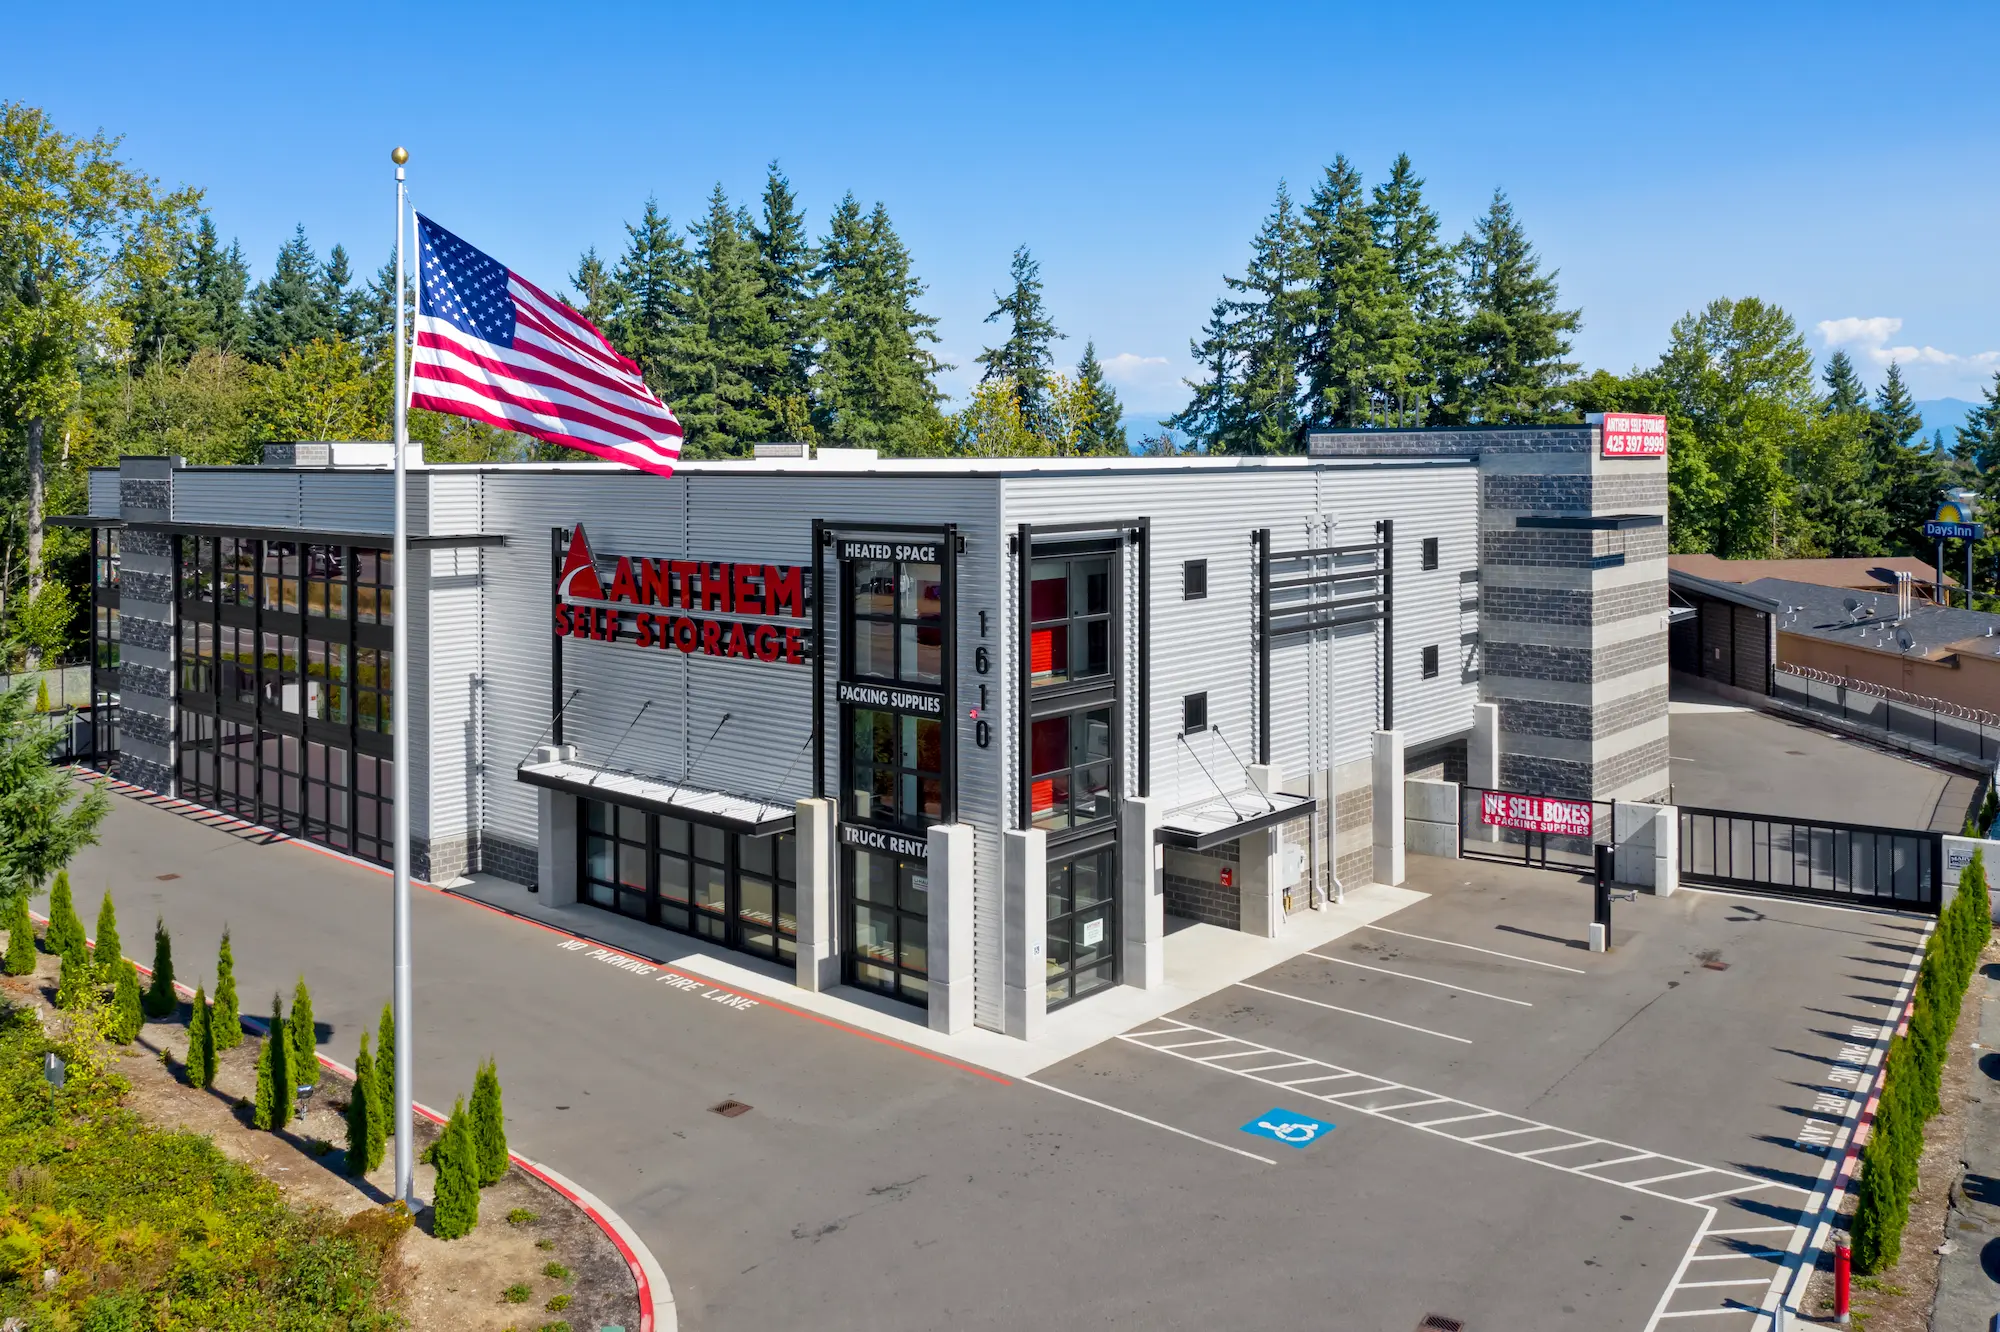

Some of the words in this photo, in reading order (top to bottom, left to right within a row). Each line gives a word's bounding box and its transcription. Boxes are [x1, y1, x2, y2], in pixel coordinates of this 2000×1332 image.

[1606, 418, 1630, 431] ANTHEM
[1630, 418, 1642, 433] SELF
[1642, 419, 1665, 433] STORAGE
[1606, 435, 1624, 452] 425
[1625, 435, 1642, 452] 397
[1643, 436, 1664, 452] 9999
[1927, 523, 1953, 536] Days
[1954, 525, 1972, 537] Inn
[845, 543, 891, 559] HEATED
[895, 545, 935, 562] SPACE
[610, 556, 804, 618] ANTHEM
[555, 603, 619, 643] SELF
[636, 612, 805, 665] STORAGE
[975, 610, 989, 748] 1610
[840, 685, 888, 706] PACKING
[891, 692, 940, 713] SUPPLIES
[1483, 814, 1491, 823] &
[1495, 816, 1537, 830] PACKING
[1540, 822, 1589, 835] SUPPLIES
[1484, 794, 1506, 817] WE
[1509, 797, 1542, 821] SELL
[1543, 801, 1590, 827] BOXES
[845, 827, 886, 849] TRUCK
[890, 836, 929, 858] RENTA
[556, 939, 589, 951] NO
[585, 948, 658, 976] PARKING
[656, 973, 704, 992] FIRE
[701, 988, 760, 1011] LANE
[1848, 1025, 1881, 1039] NO
[1827, 1042, 1872, 1083] PARKING
[1812, 1086, 1850, 1114] FIRE
[1795, 1118, 1834, 1152] LANE
